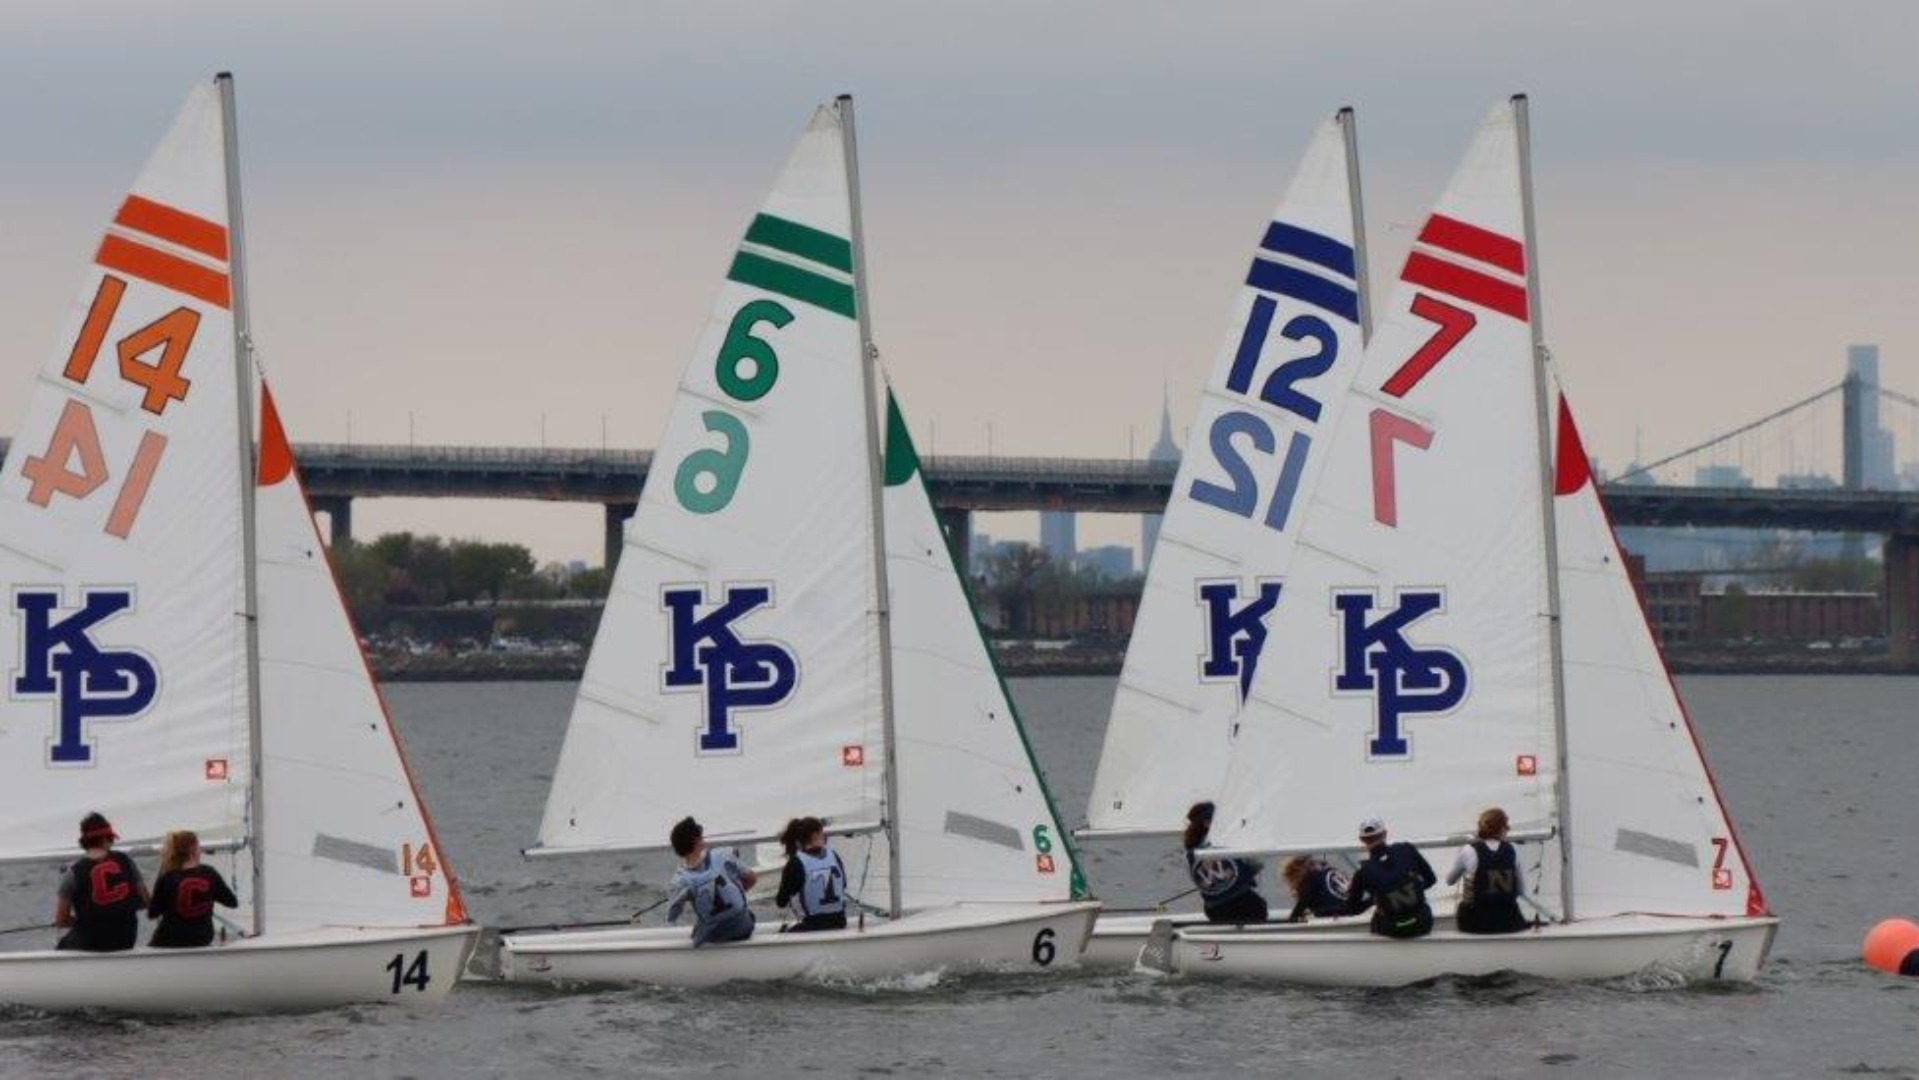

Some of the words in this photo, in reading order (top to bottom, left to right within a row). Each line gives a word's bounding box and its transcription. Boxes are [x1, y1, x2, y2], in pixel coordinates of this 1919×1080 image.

[63, 274, 202, 416] 14
[715, 299, 795, 401] 6
[1226, 294, 1338, 423] 12
[1380, 292, 1477, 398] 7
[14, 590, 159, 762] KP
[663, 586, 797, 752] KP
[1334, 592, 1468, 756] KP
[403, 842, 436, 876] 14
[1032, 824, 1052, 853] 6
[1711, 838, 1728, 868] 7
[91, 860, 129, 906] C
[178, 876, 212, 919] C
[1486, 868, 1514, 894] N
[1032, 927, 1056, 966] 6
[386, 950, 431, 994] 14
